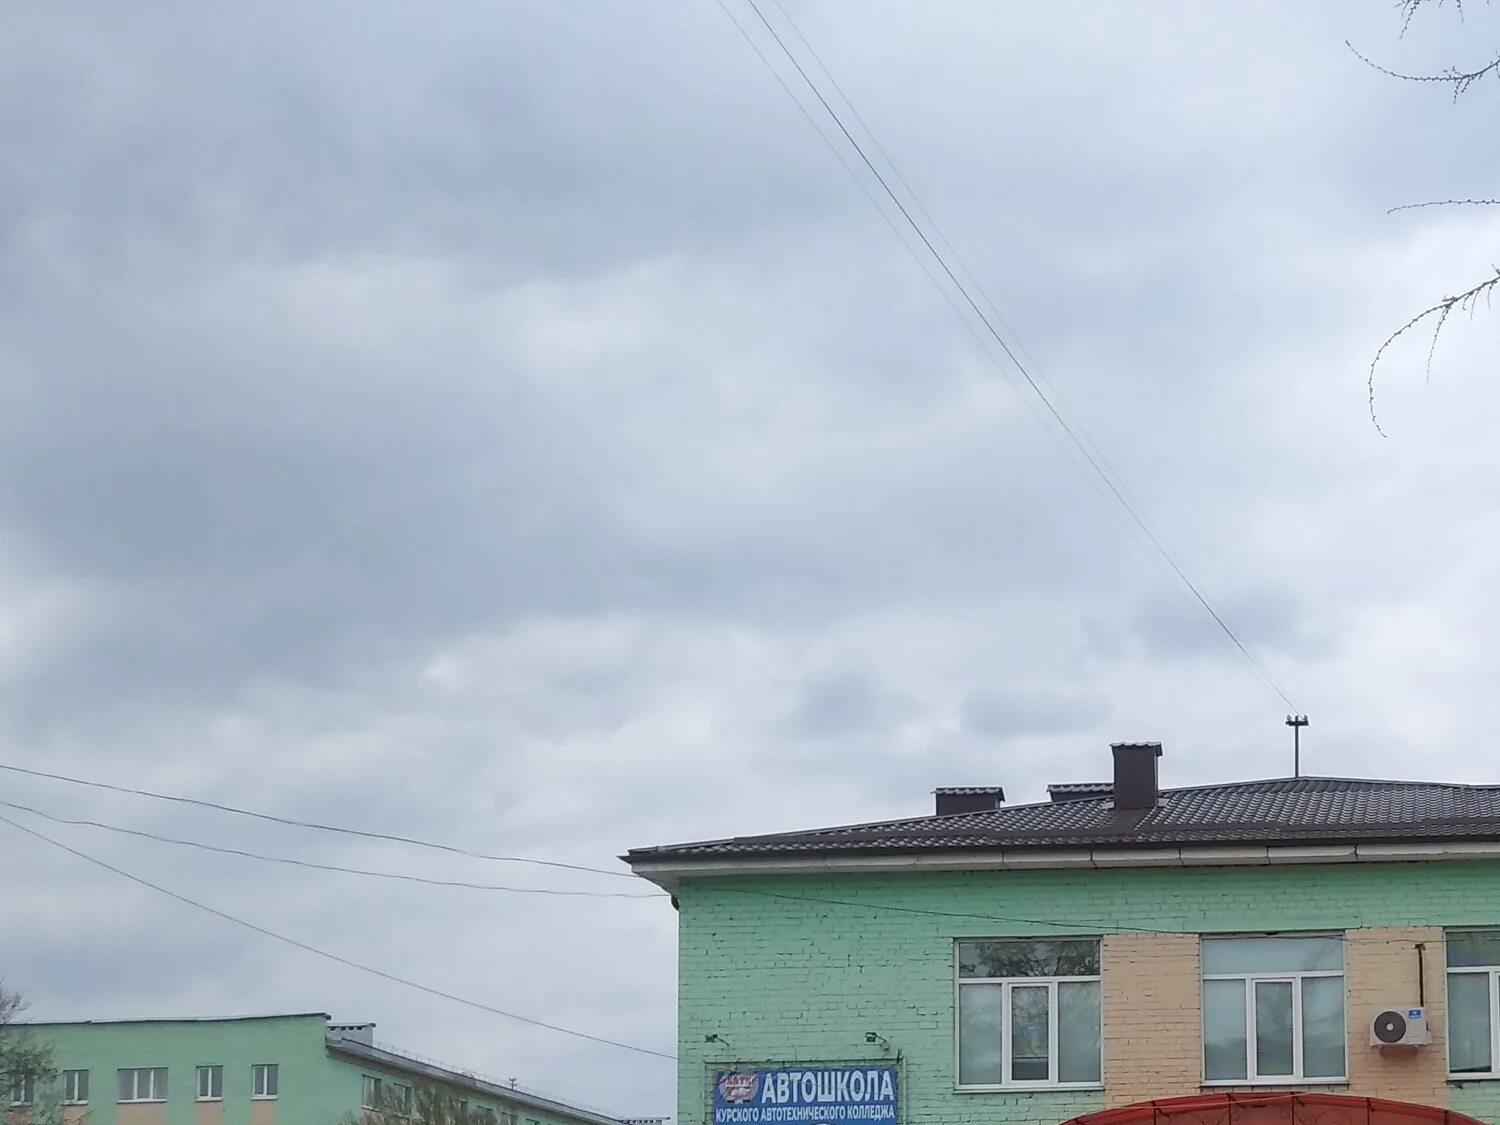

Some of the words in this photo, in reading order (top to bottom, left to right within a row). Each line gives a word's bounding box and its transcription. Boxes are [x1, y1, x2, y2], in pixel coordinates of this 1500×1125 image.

[761, 1070, 895, 1104] АВТОШКОЛА
[715, 1106, 759, 1122] КУРСКОГО
[760, 1105, 845, 1122] АВТОТЕХНИЧЕСКОГО
[847, 1104, 895, 1121] КОЛЛЕДЖА
